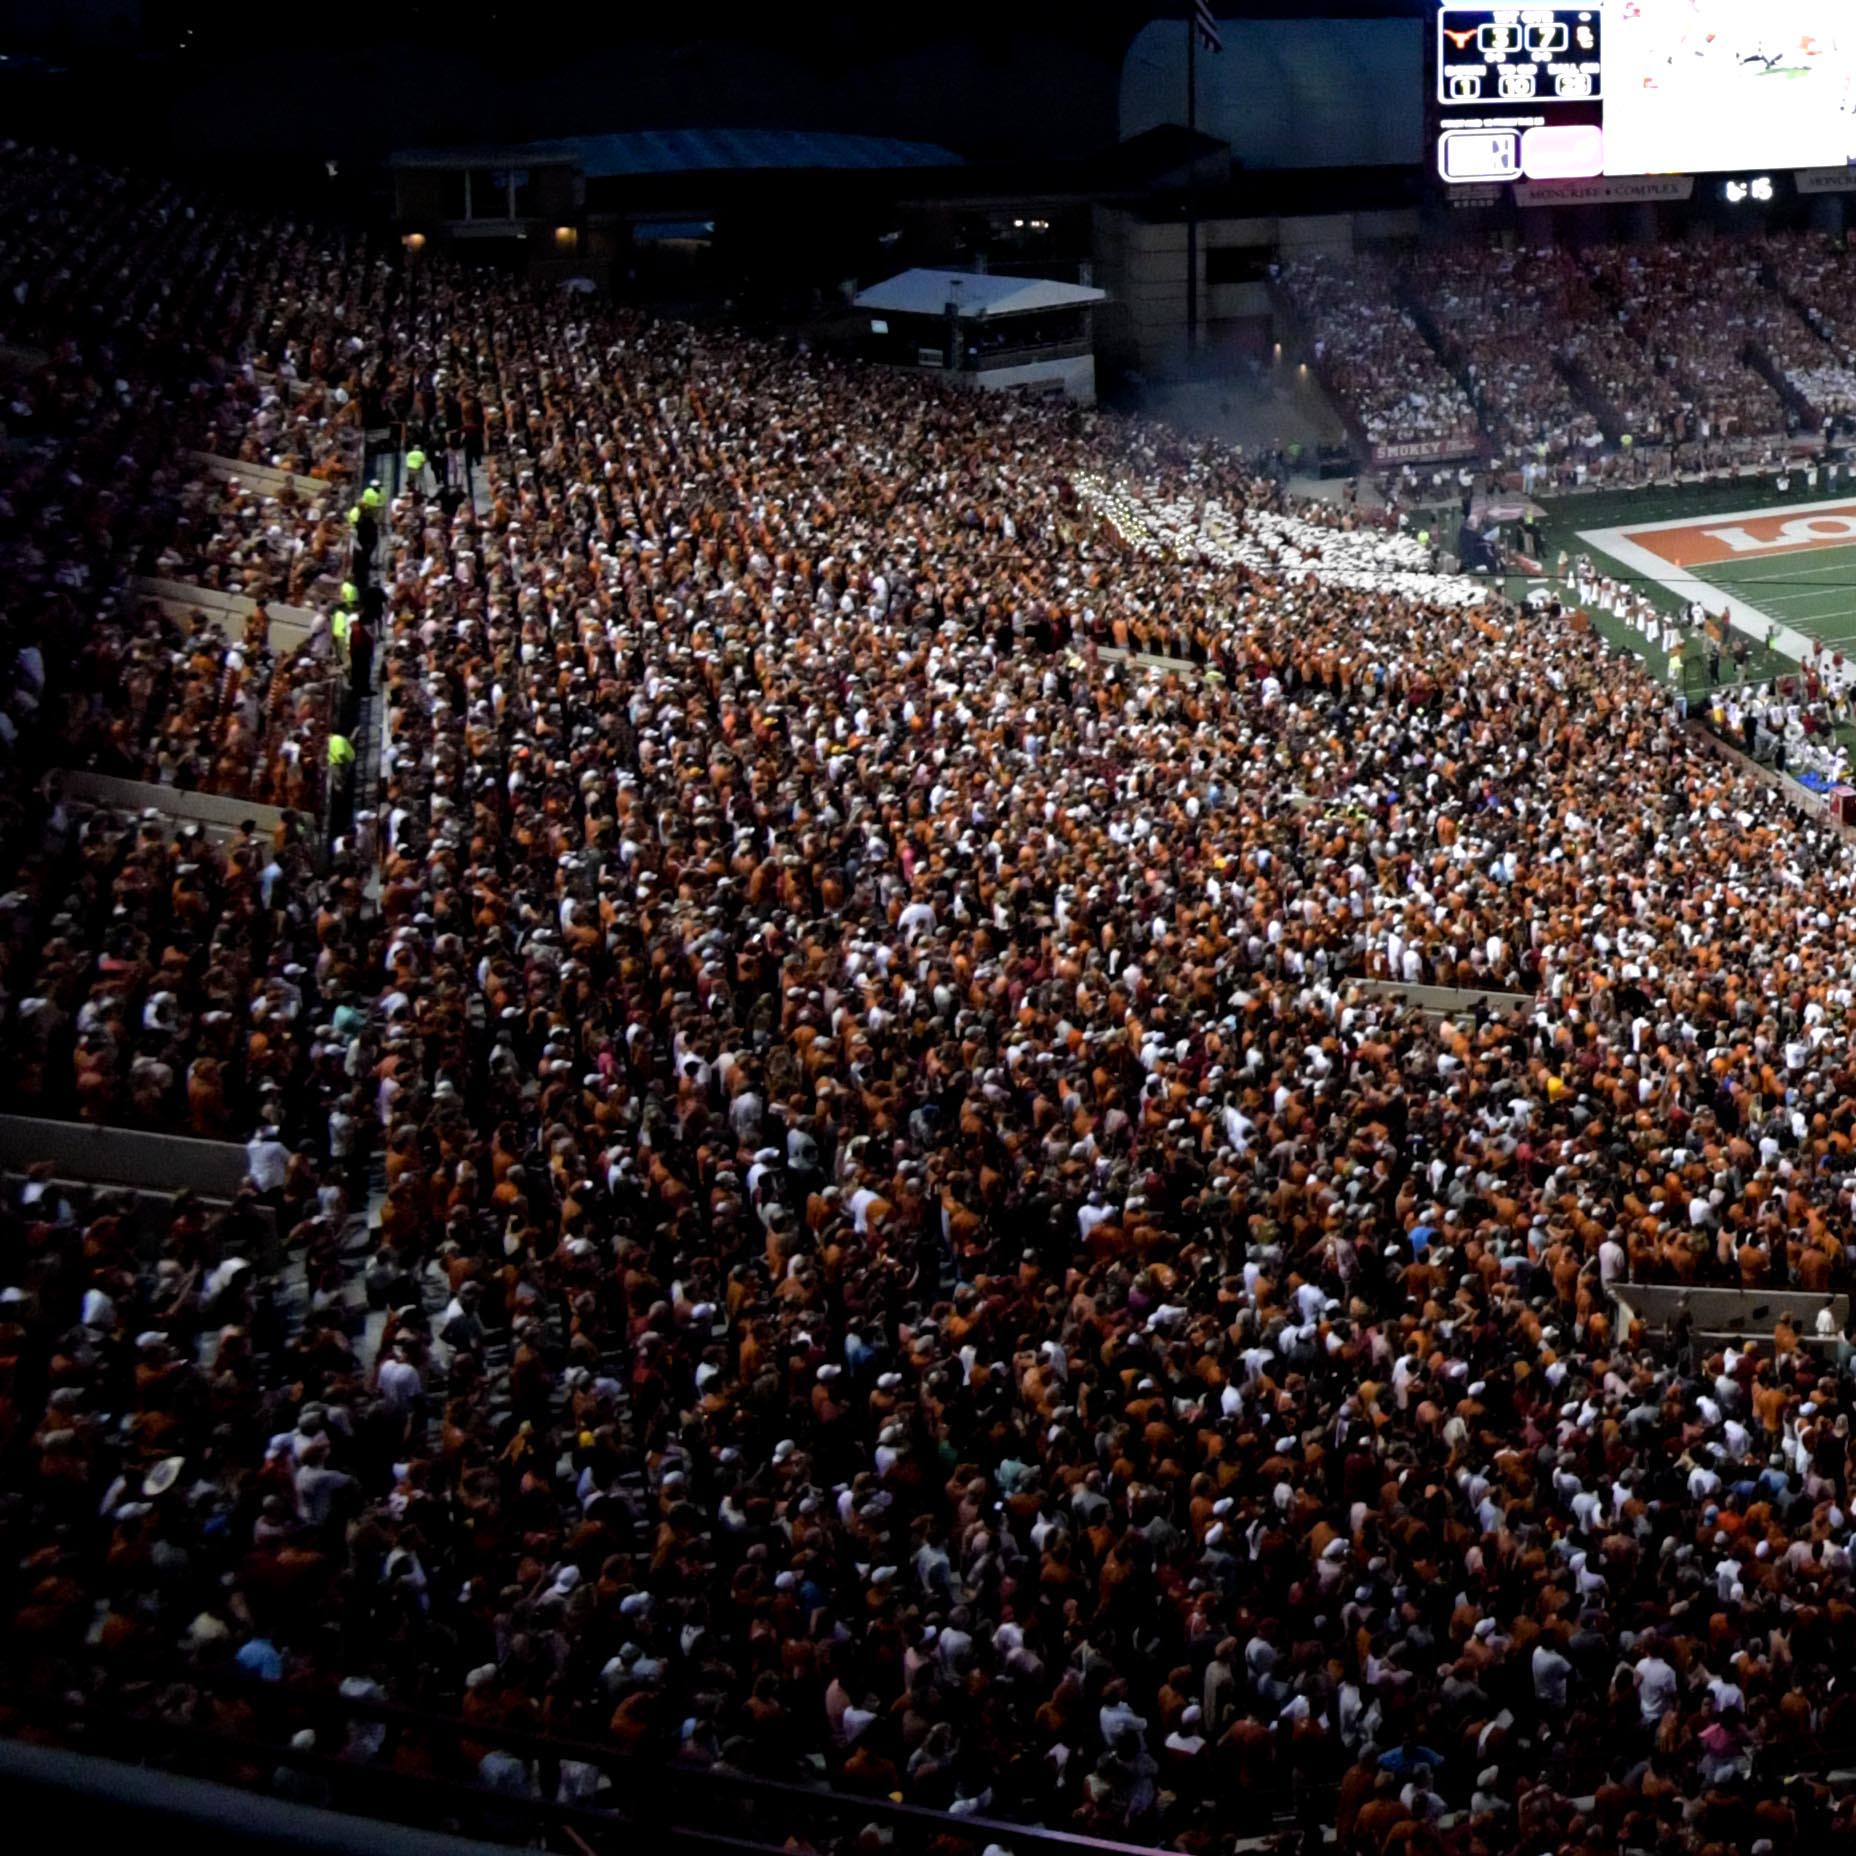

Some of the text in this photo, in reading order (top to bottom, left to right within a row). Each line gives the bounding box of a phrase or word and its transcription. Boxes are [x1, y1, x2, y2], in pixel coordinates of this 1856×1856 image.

[1539, 27, 1555, 48] 7
[1616, 183, 1679, 195] COMPLEX
[1376, 441, 1440, 459] SMOKEY
